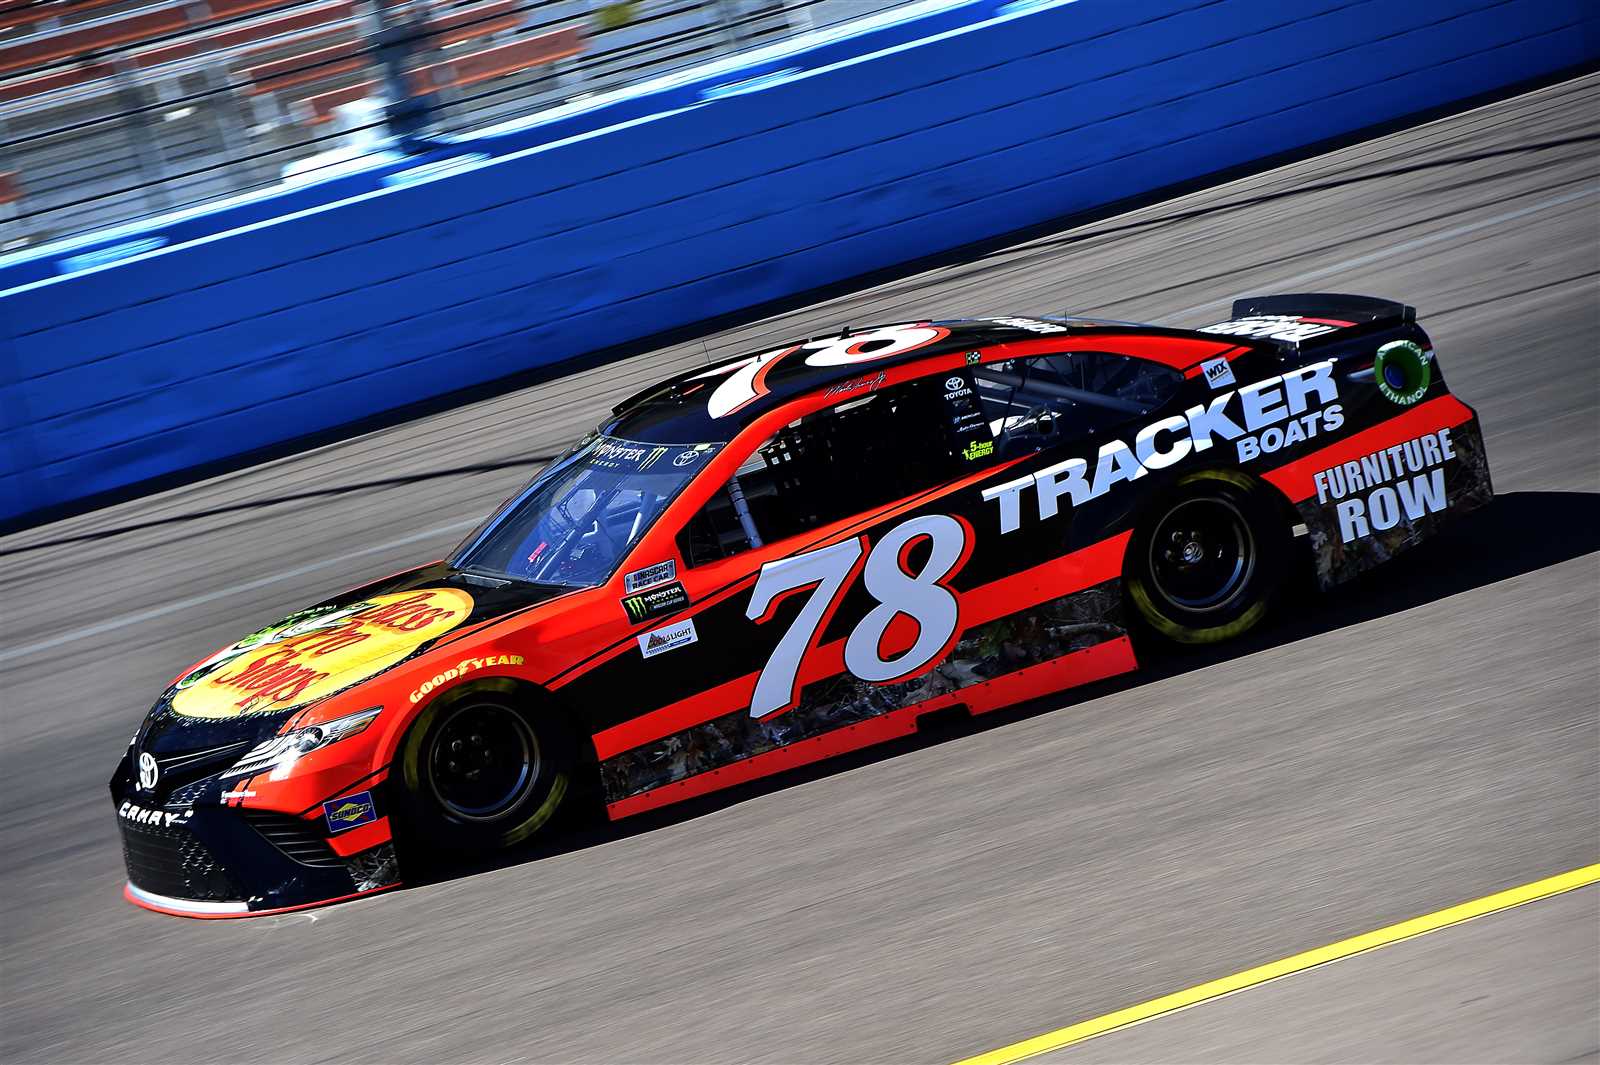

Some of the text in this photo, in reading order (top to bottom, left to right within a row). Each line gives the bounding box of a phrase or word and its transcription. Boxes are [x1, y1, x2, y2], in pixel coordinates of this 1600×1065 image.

[1206, 361, 1227, 379] WIX
[944, 388, 972, 400] TOYOTA
[1379, 382, 1428, 405] ETHANOL
[1237, 404, 1345, 464] BOATS
[593, 442, 646, 462] MONSTER
[982, 358, 1339, 535] TRACKER
[1313, 427, 1456, 505] FURNITURE
[1335, 469, 1449, 544] ROW
[632, 572, 669, 590] RACE CAR
[644, 586, 682, 603] MONSTER
[745, 513, 970, 720] 78
[670, 627, 692, 640] LIGHT
[409, 655, 526, 704] GOODYEAR
[329, 803, 371, 821] SUNOCO
